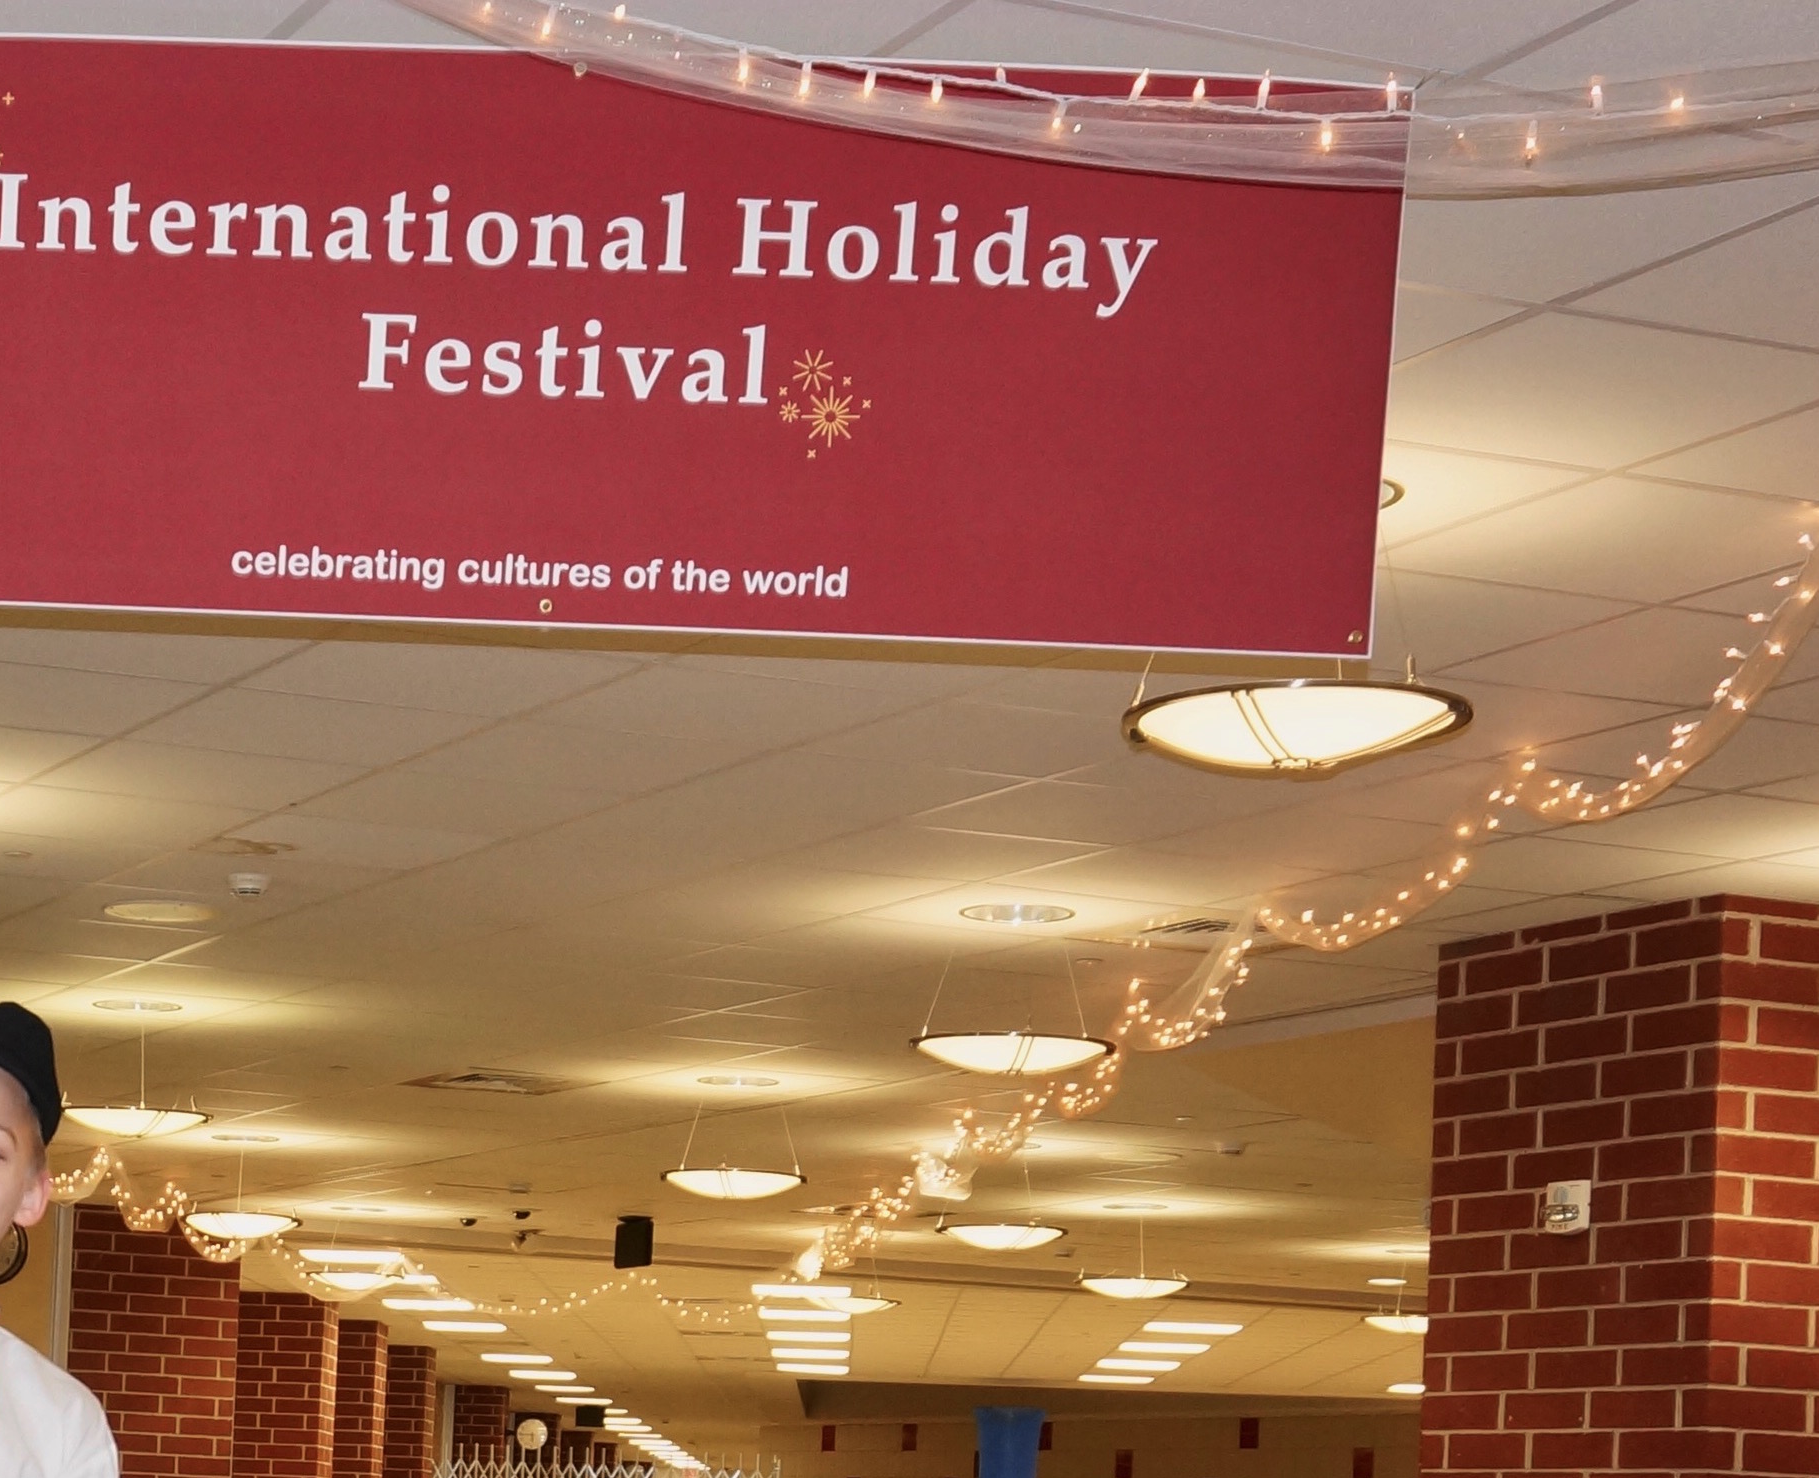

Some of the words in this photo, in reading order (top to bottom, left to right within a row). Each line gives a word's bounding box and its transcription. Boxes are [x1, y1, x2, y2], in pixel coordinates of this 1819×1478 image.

[731, 197, 1159, 318] Holiday
[357, 312, 769, 405] Festival
[231, 545, 446, 591] celebrating
[457, 552, 612, 589] cultures
[623, 558, 664, 591] of
[671, 559, 731, 594] the
[742, 565, 849, 598] world
